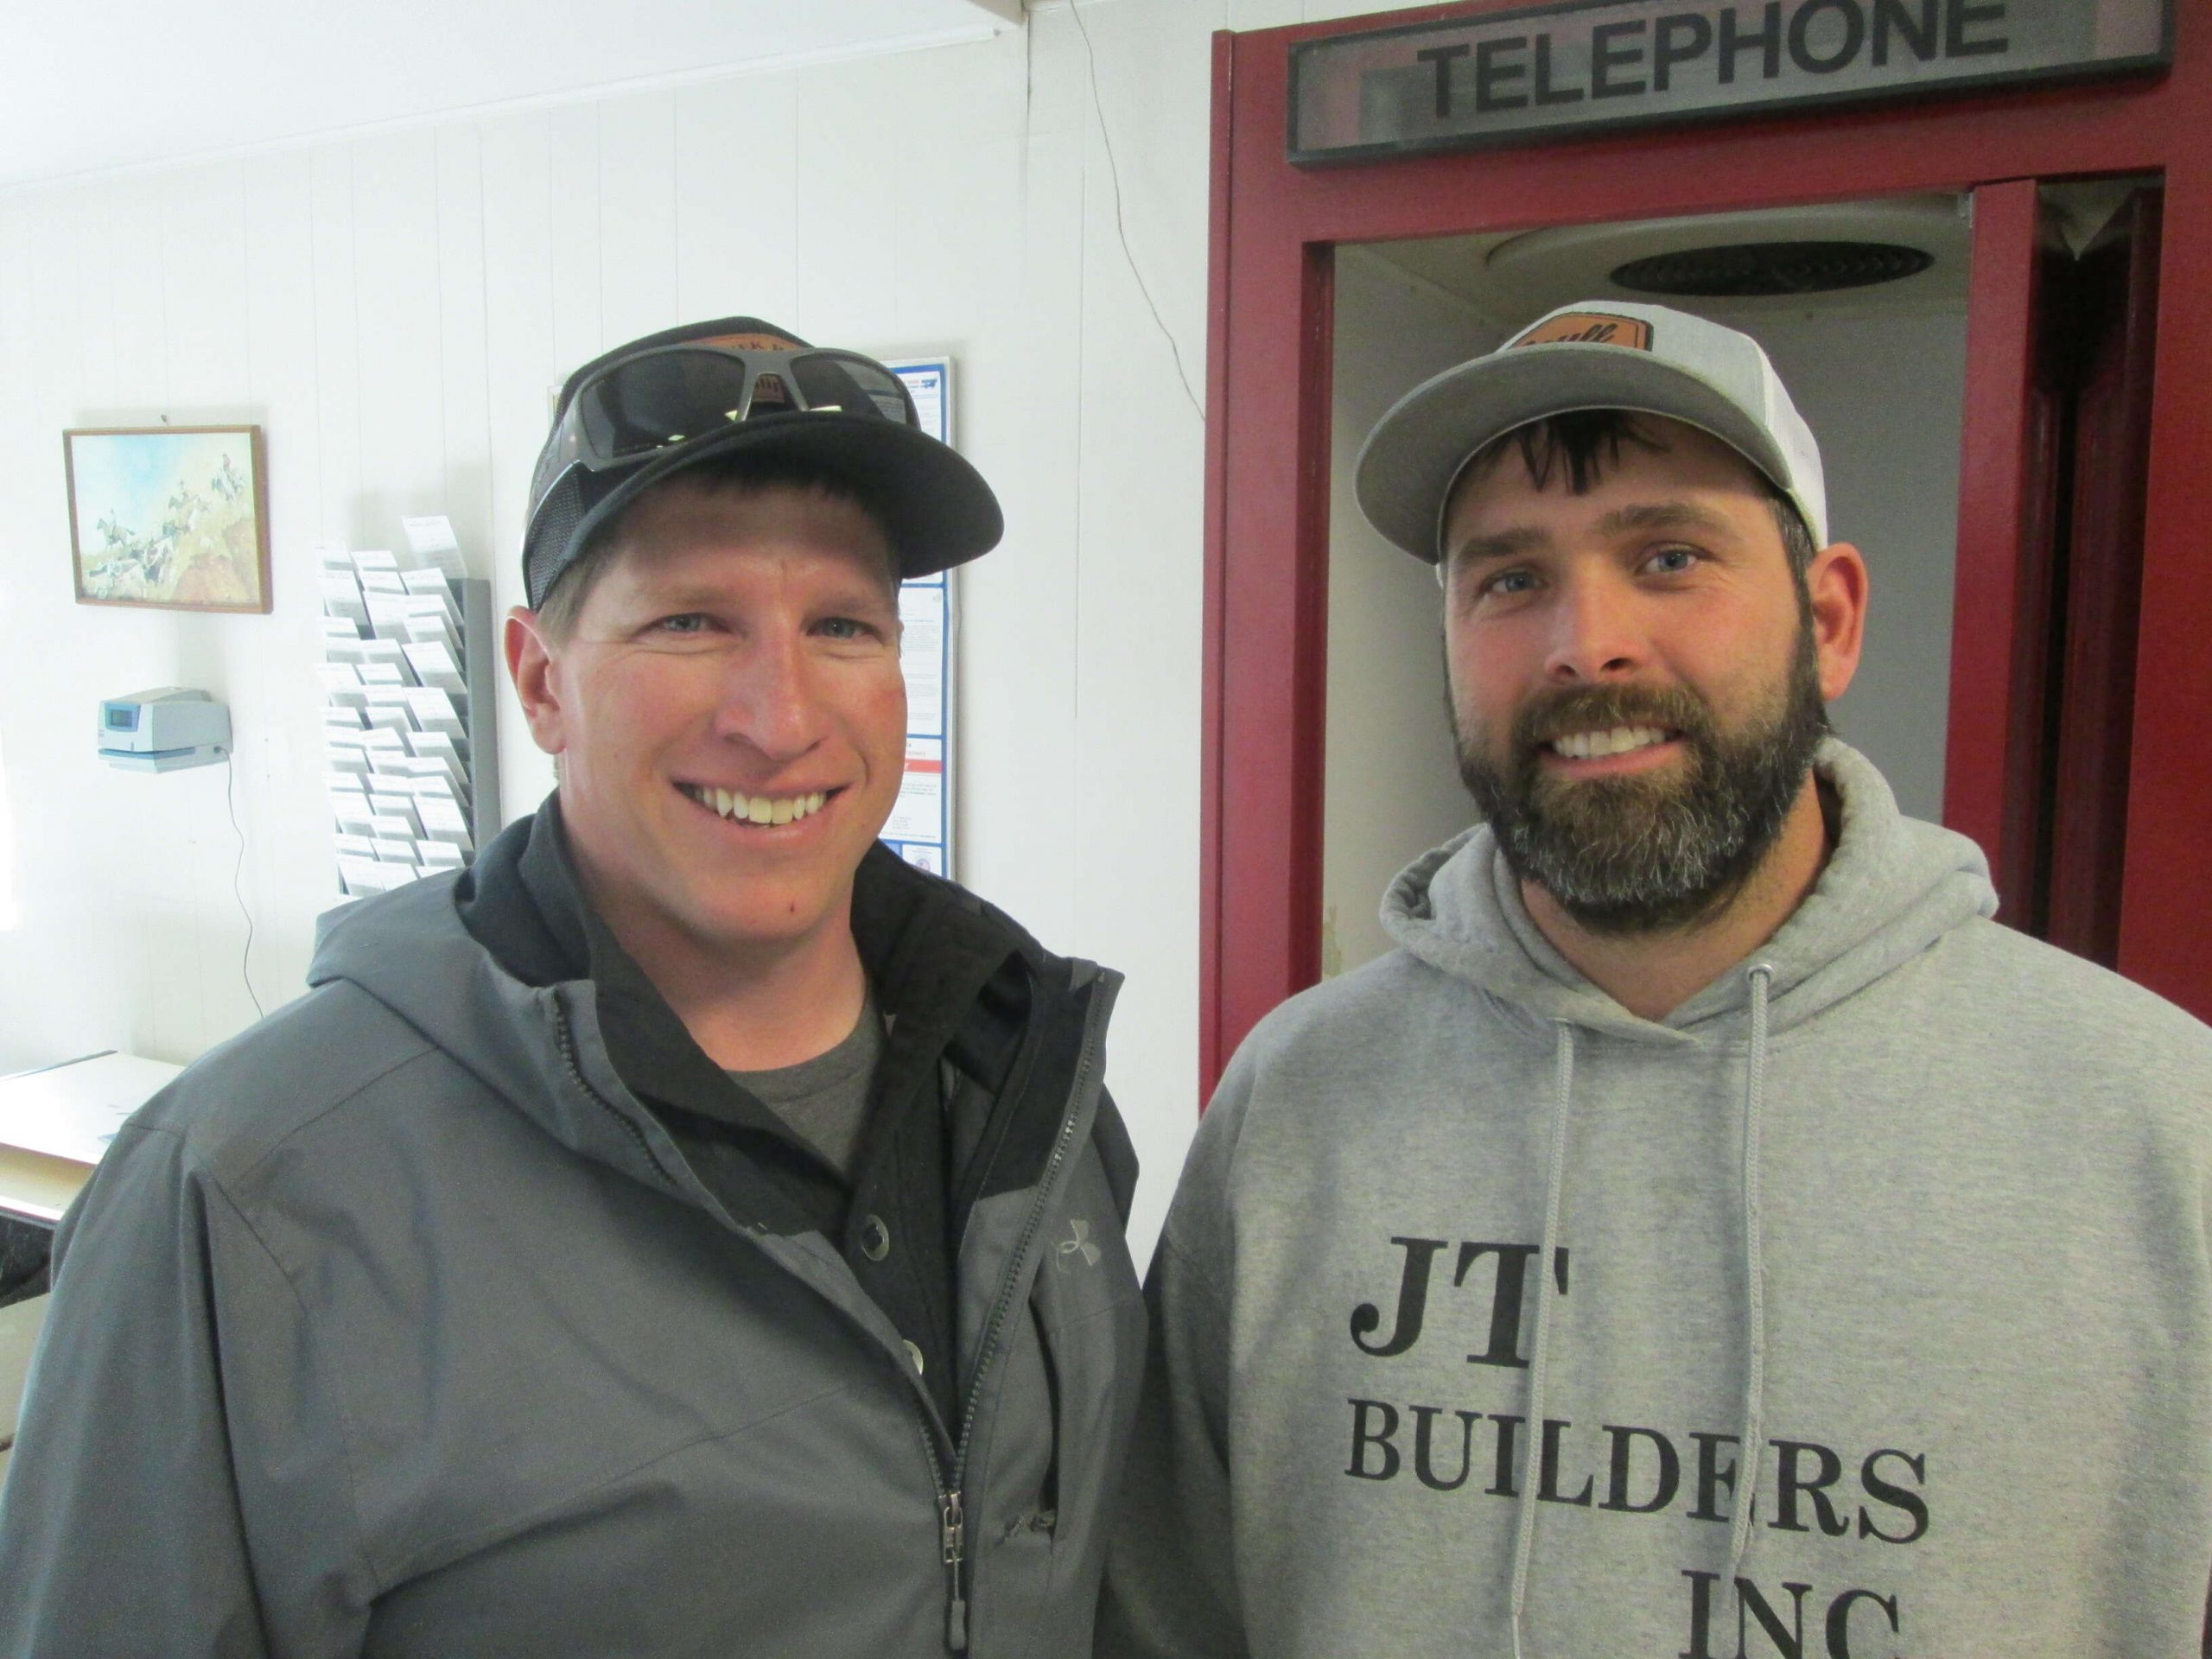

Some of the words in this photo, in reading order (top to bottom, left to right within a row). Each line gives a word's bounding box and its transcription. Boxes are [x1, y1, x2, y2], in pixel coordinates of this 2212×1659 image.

[1417, 0, 2010, 118] TELEPHONE
[1350, 1236, 1569, 1369] JT
[1344, 1398, 1929, 1545] BUILDERS
[1678, 1569, 1899, 1659] INC
